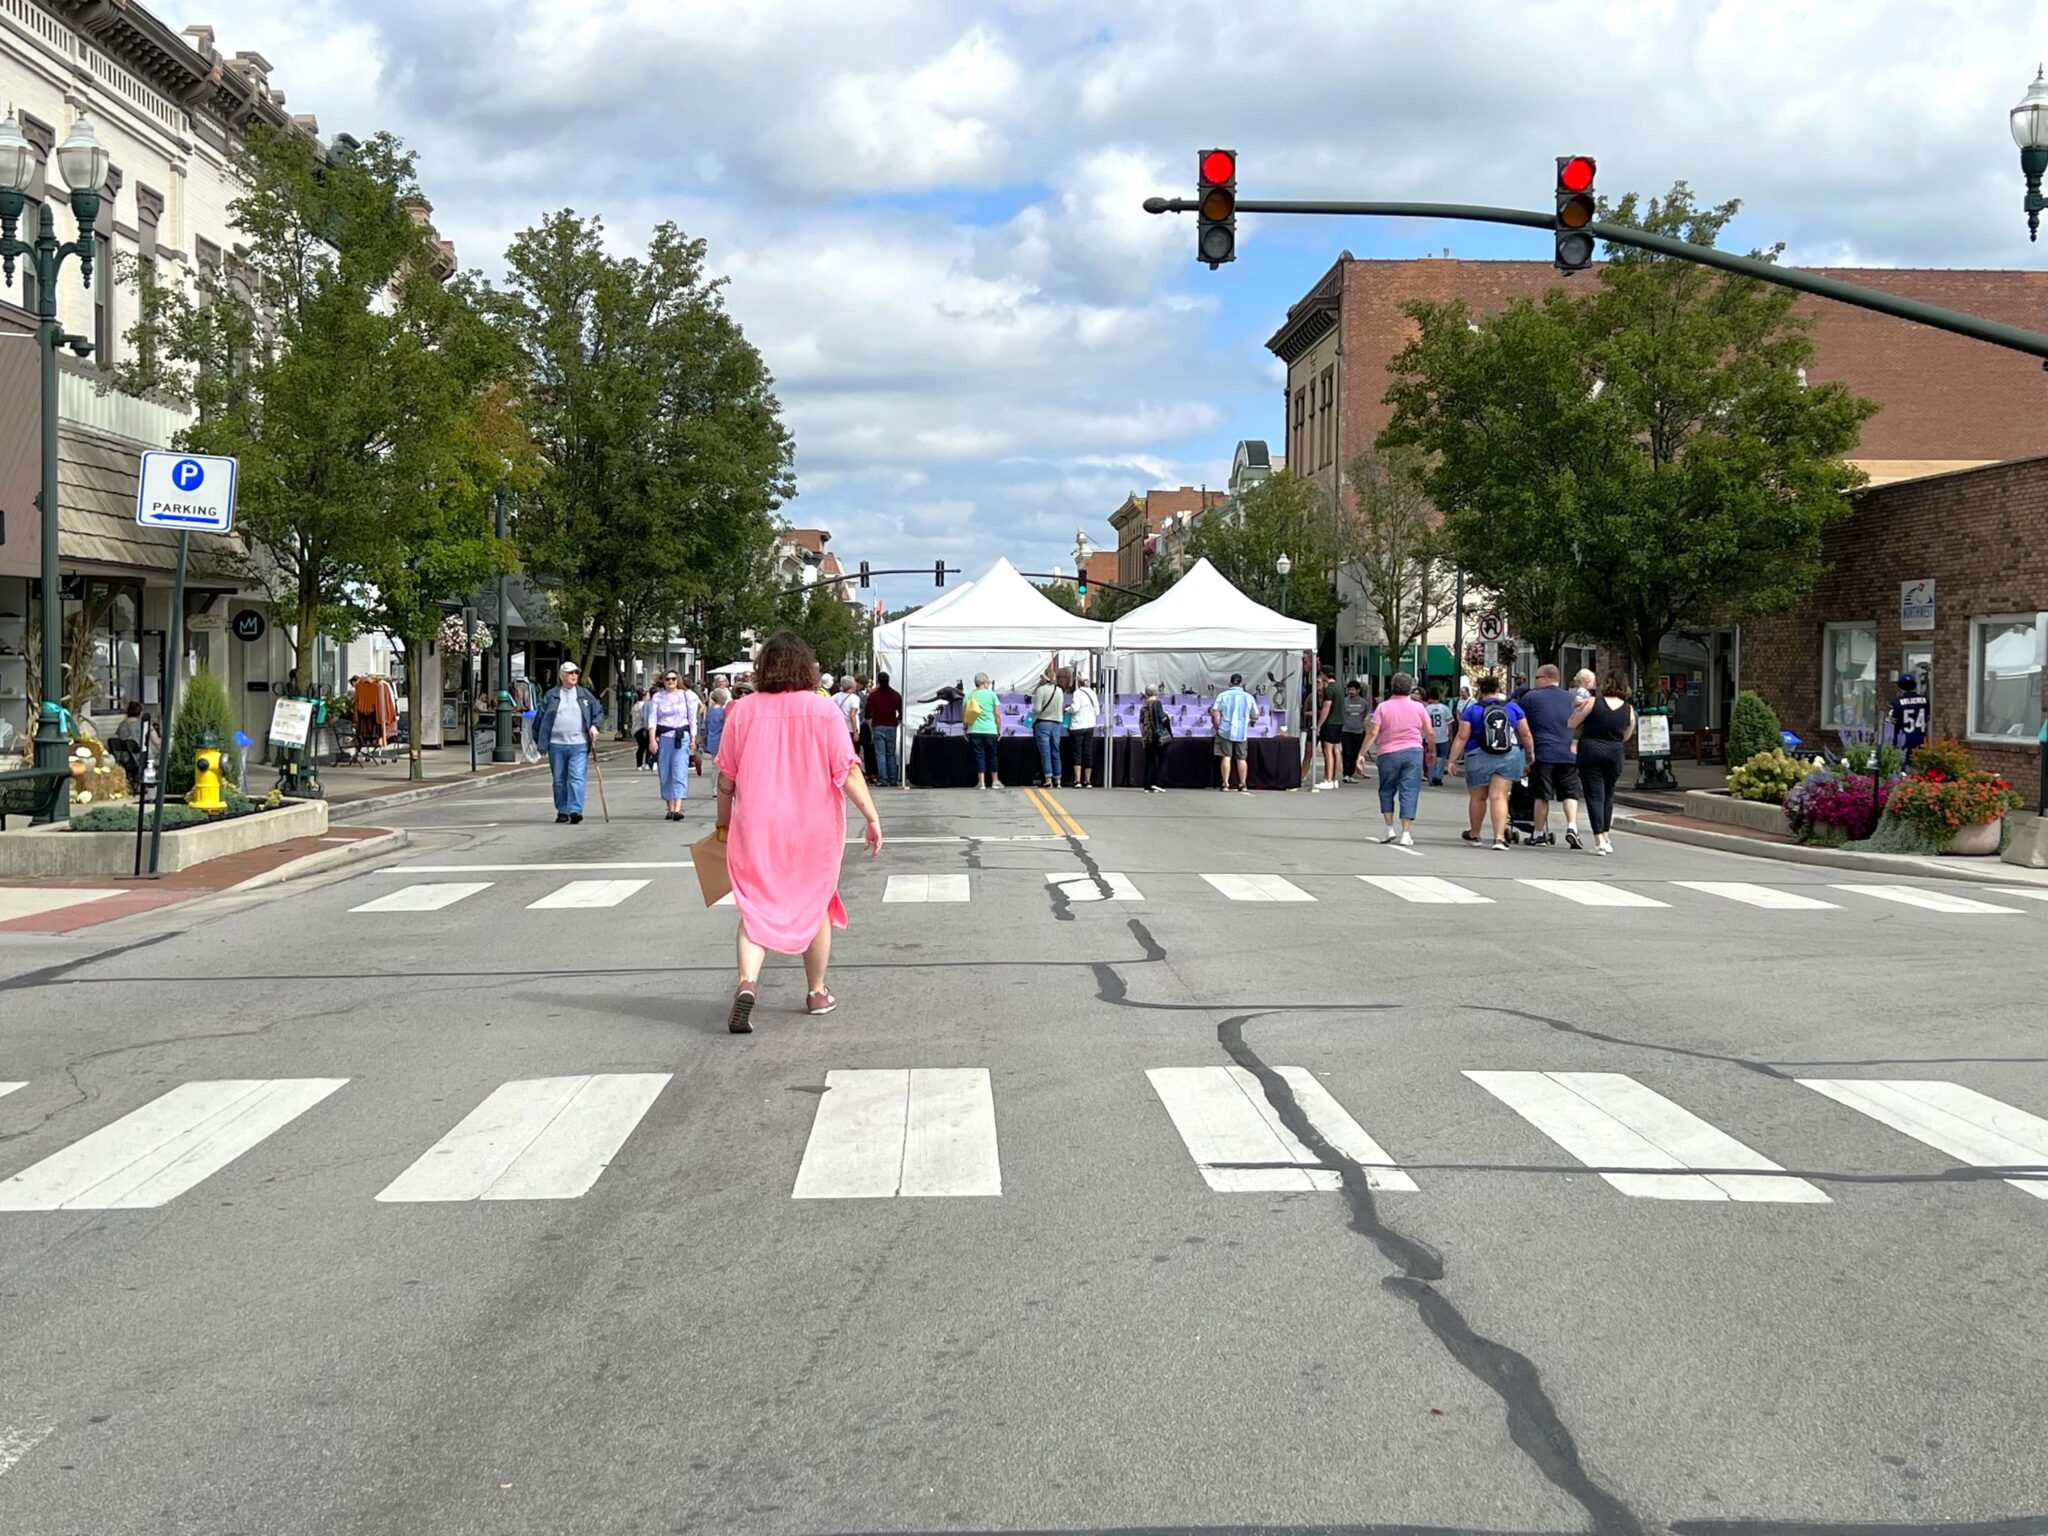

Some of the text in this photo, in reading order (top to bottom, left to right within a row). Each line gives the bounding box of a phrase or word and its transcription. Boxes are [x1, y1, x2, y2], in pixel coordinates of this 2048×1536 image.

[180, 463, 199, 486] P
[152, 502, 217, 516] PARKING
[1430, 714, 1442, 728] 18
[1903, 708, 1926, 733] 54
